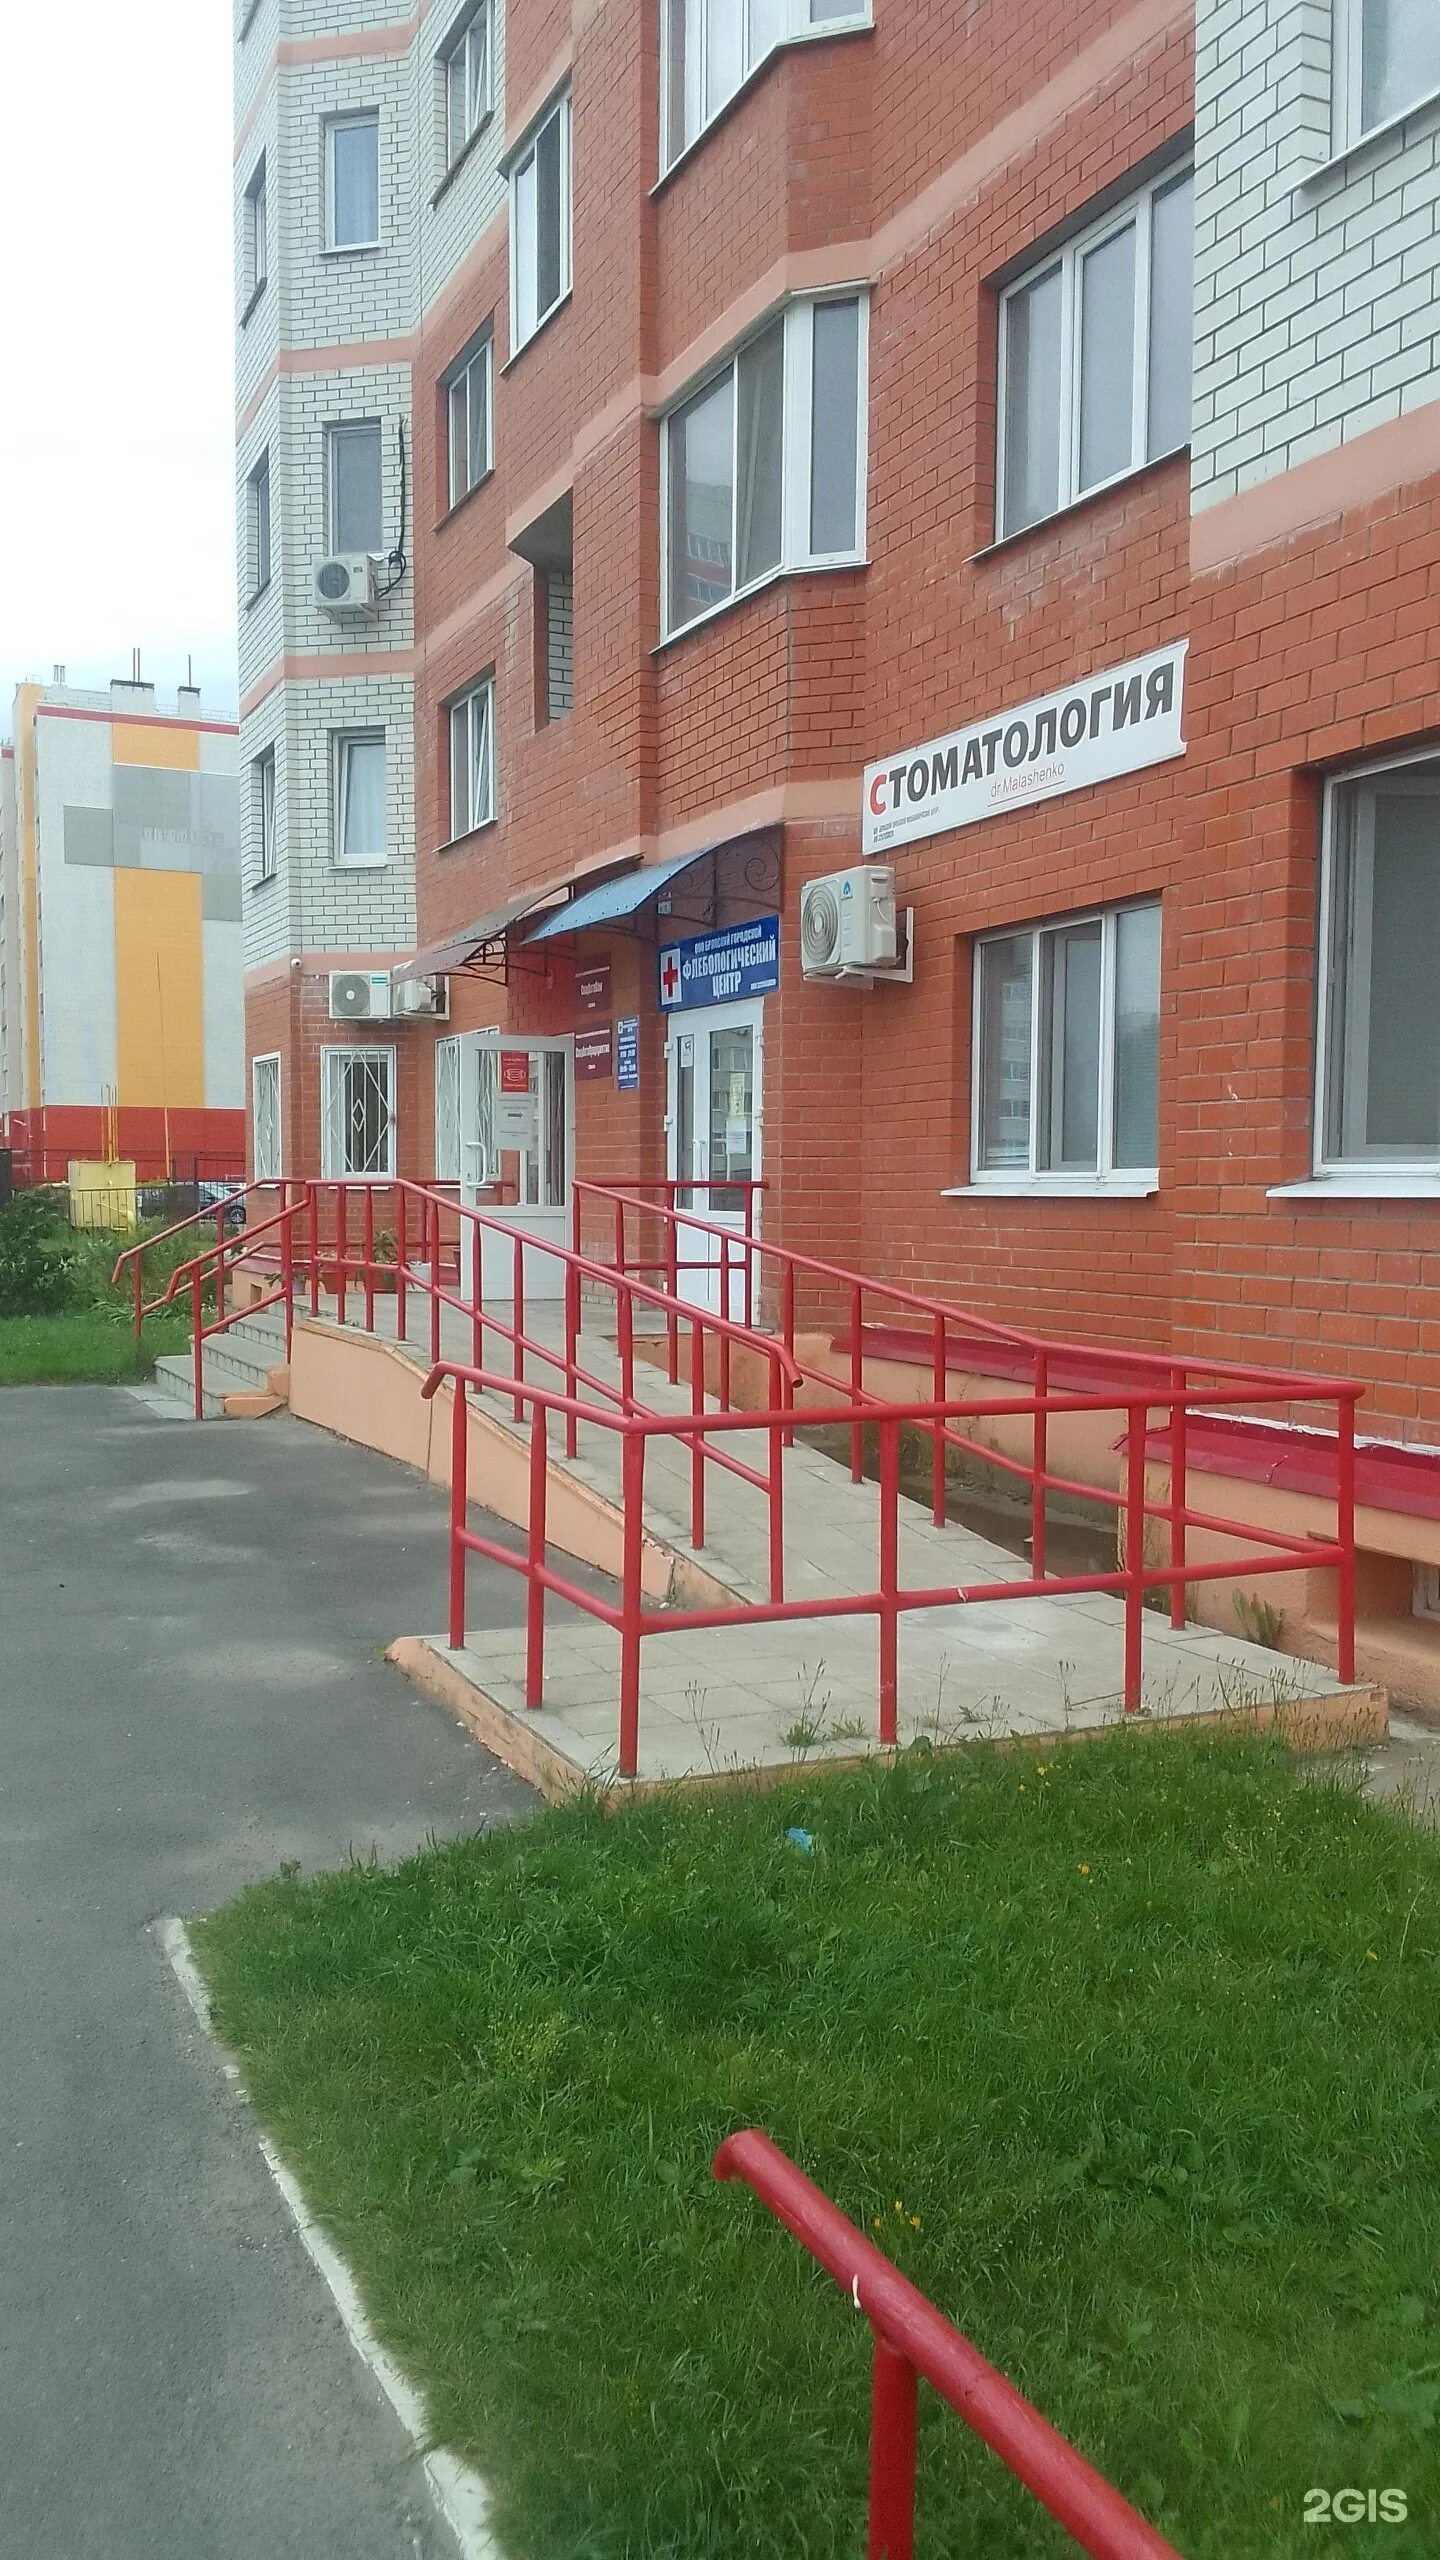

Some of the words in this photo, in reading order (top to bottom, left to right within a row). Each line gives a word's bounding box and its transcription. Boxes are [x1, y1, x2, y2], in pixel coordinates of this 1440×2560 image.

[870, 661, 1175, 816] СТОМАТОЛОГИЯ
[990, 762, 1065, 798] dr.Malashenko
[731, 924, 762, 945] ГОРОДСКОЙ
[682, 934, 777, 981] ФЛЕБОЛОГИЧЕСКИЙ
[712, 971, 742, 999] ЦЕНТР
